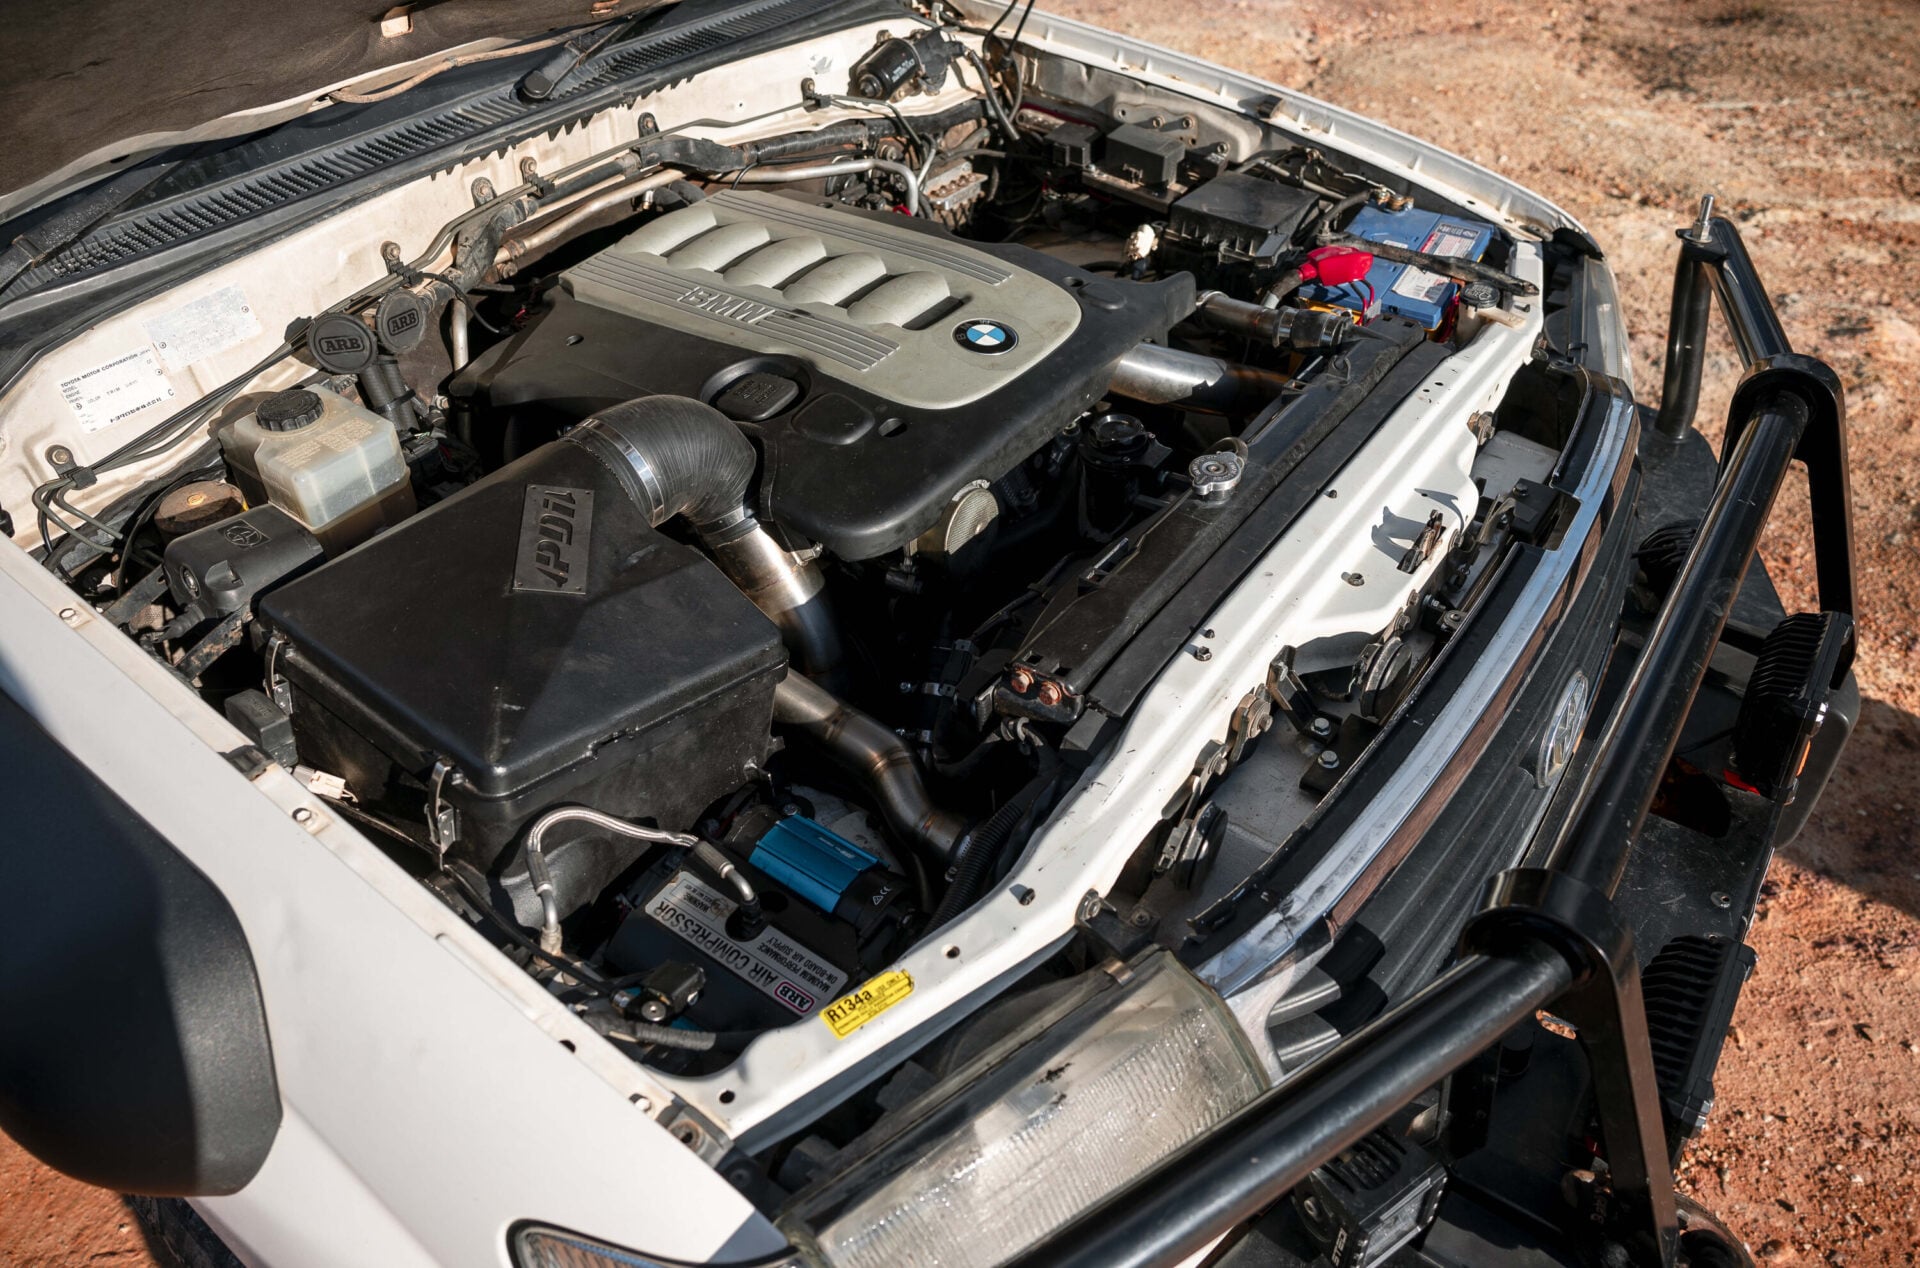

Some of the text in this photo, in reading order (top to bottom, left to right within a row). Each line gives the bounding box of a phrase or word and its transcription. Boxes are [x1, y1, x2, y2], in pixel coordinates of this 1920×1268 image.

[391, 312, 417, 333] ARB
[677, 286, 776, 324] BMW
[325, 337, 361, 352] ARB
[61, 377, 81, 388] TOYOTA
[82, 369, 101, 380] MOTOR
[101, 353, 138, 372] CORPORATION
[653, 901, 811, 1009] ARB AIR COMPRESSOR
[757, 942, 832, 993] MAXIMUM PERFORMANCE
[765, 936, 839, 985] ON-BOARD AIR SUPPLY
[827, 990, 873, 1023] R134a
